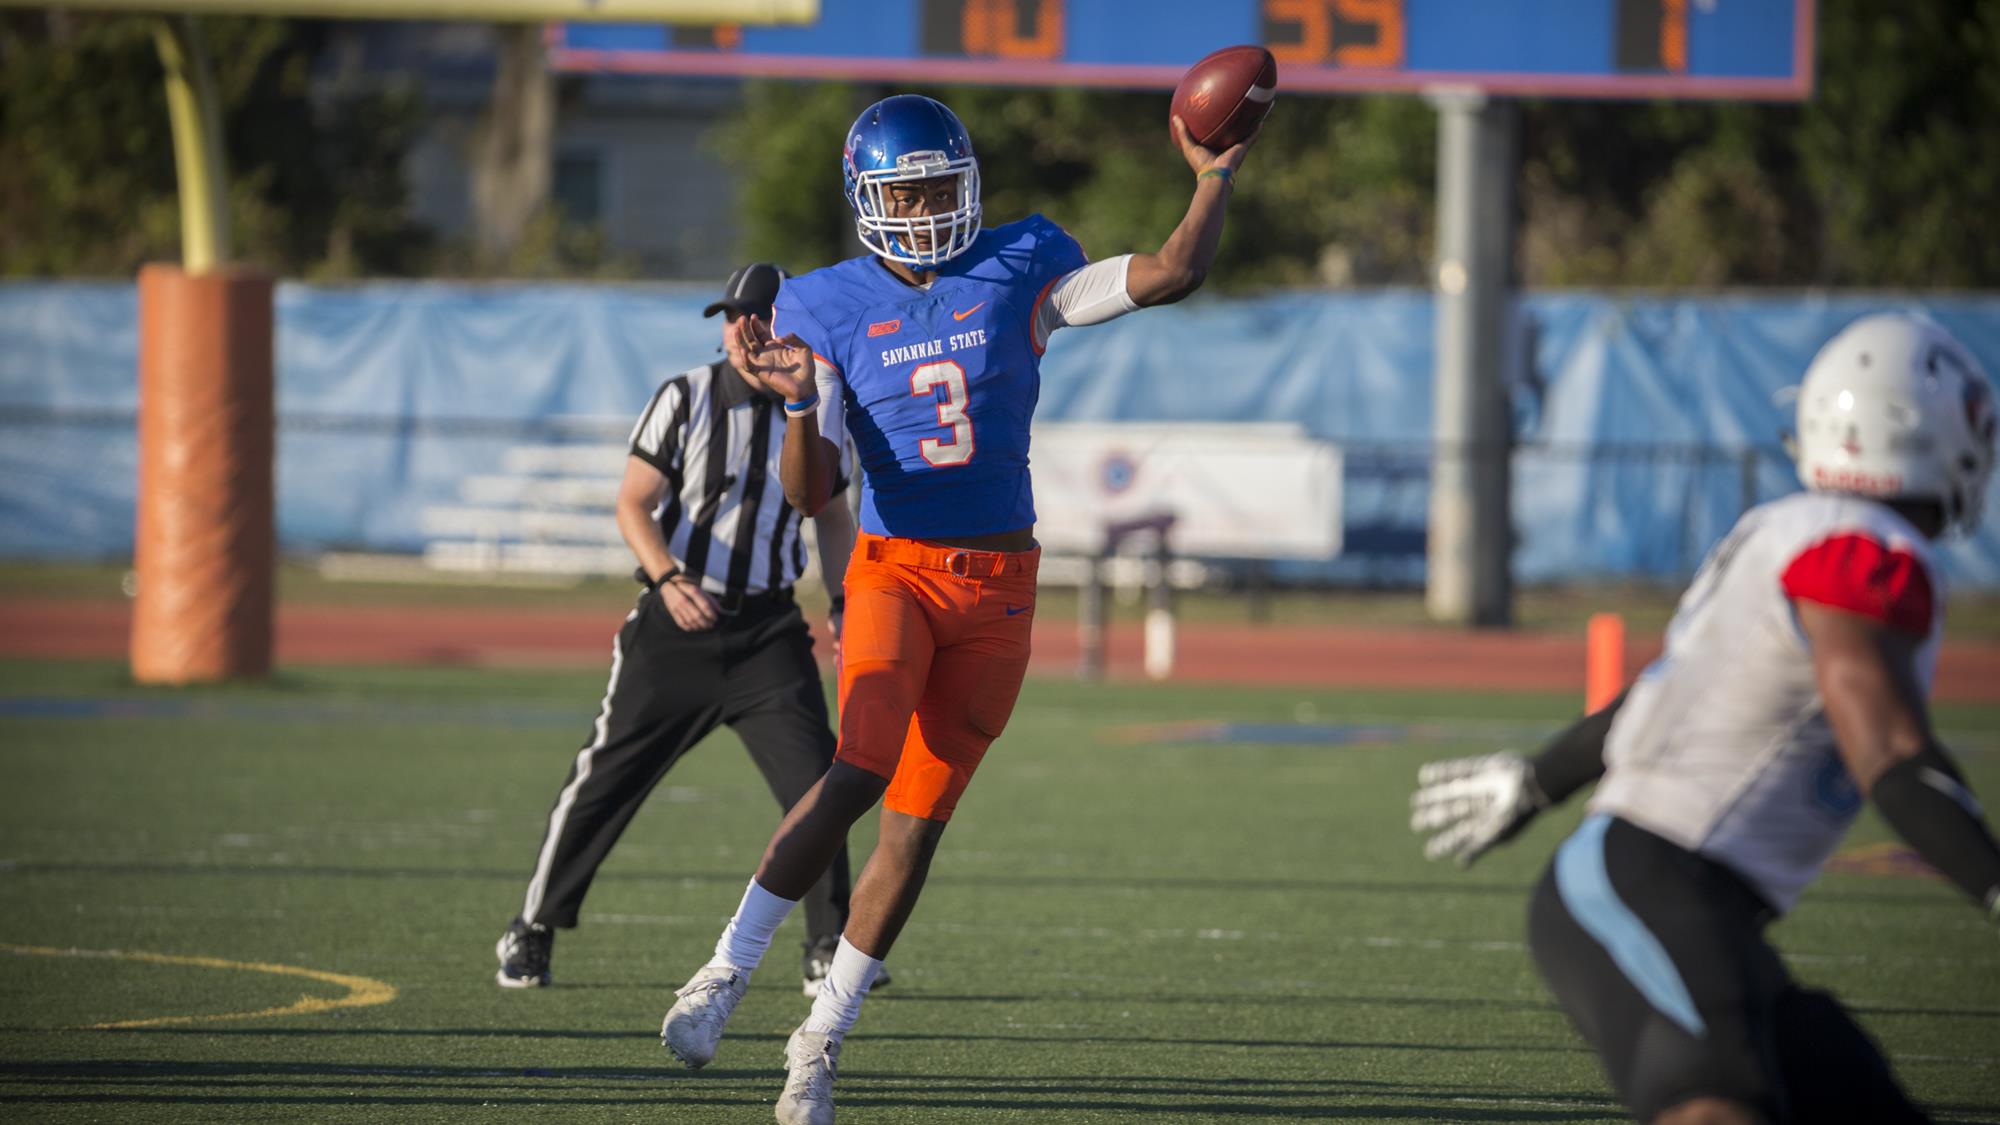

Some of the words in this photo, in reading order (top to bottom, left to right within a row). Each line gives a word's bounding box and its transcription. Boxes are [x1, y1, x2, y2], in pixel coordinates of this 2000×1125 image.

[881, 339, 943, 367] SAVANNAH
[949, 329, 987, 351] STATE
[909, 359, 976, 468] 3
